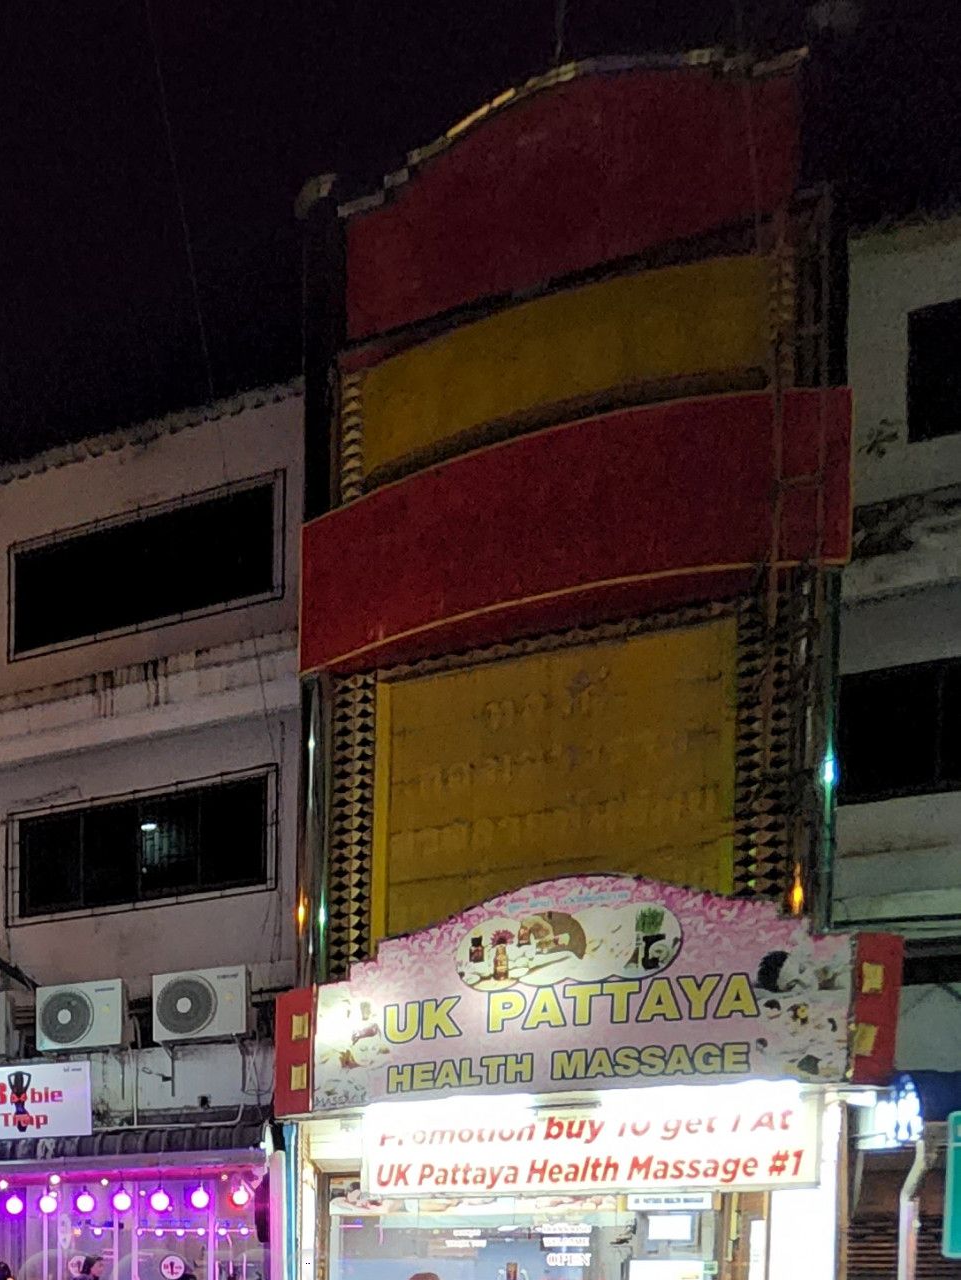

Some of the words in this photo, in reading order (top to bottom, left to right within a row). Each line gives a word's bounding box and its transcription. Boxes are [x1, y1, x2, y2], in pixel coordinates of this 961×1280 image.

[384, 996, 463, 1044] UK
[487, 973, 760, 1035] PATTAYA
[387, 1053, 534, 1094] HEALTH
[551, 1042, 750, 1080] MASSAGE
[380, 1123, 536, 1147] Pomotion
[544, 1116, 605, 1144] buy
[377, 1163, 412, 1187] UK
[418, 1161, 519, 1190] Pattaya
[526, 1155, 619, 1184] Health
[627, 1154, 759, 1183] Massage
[769, 1148, 805, 1176] #1
